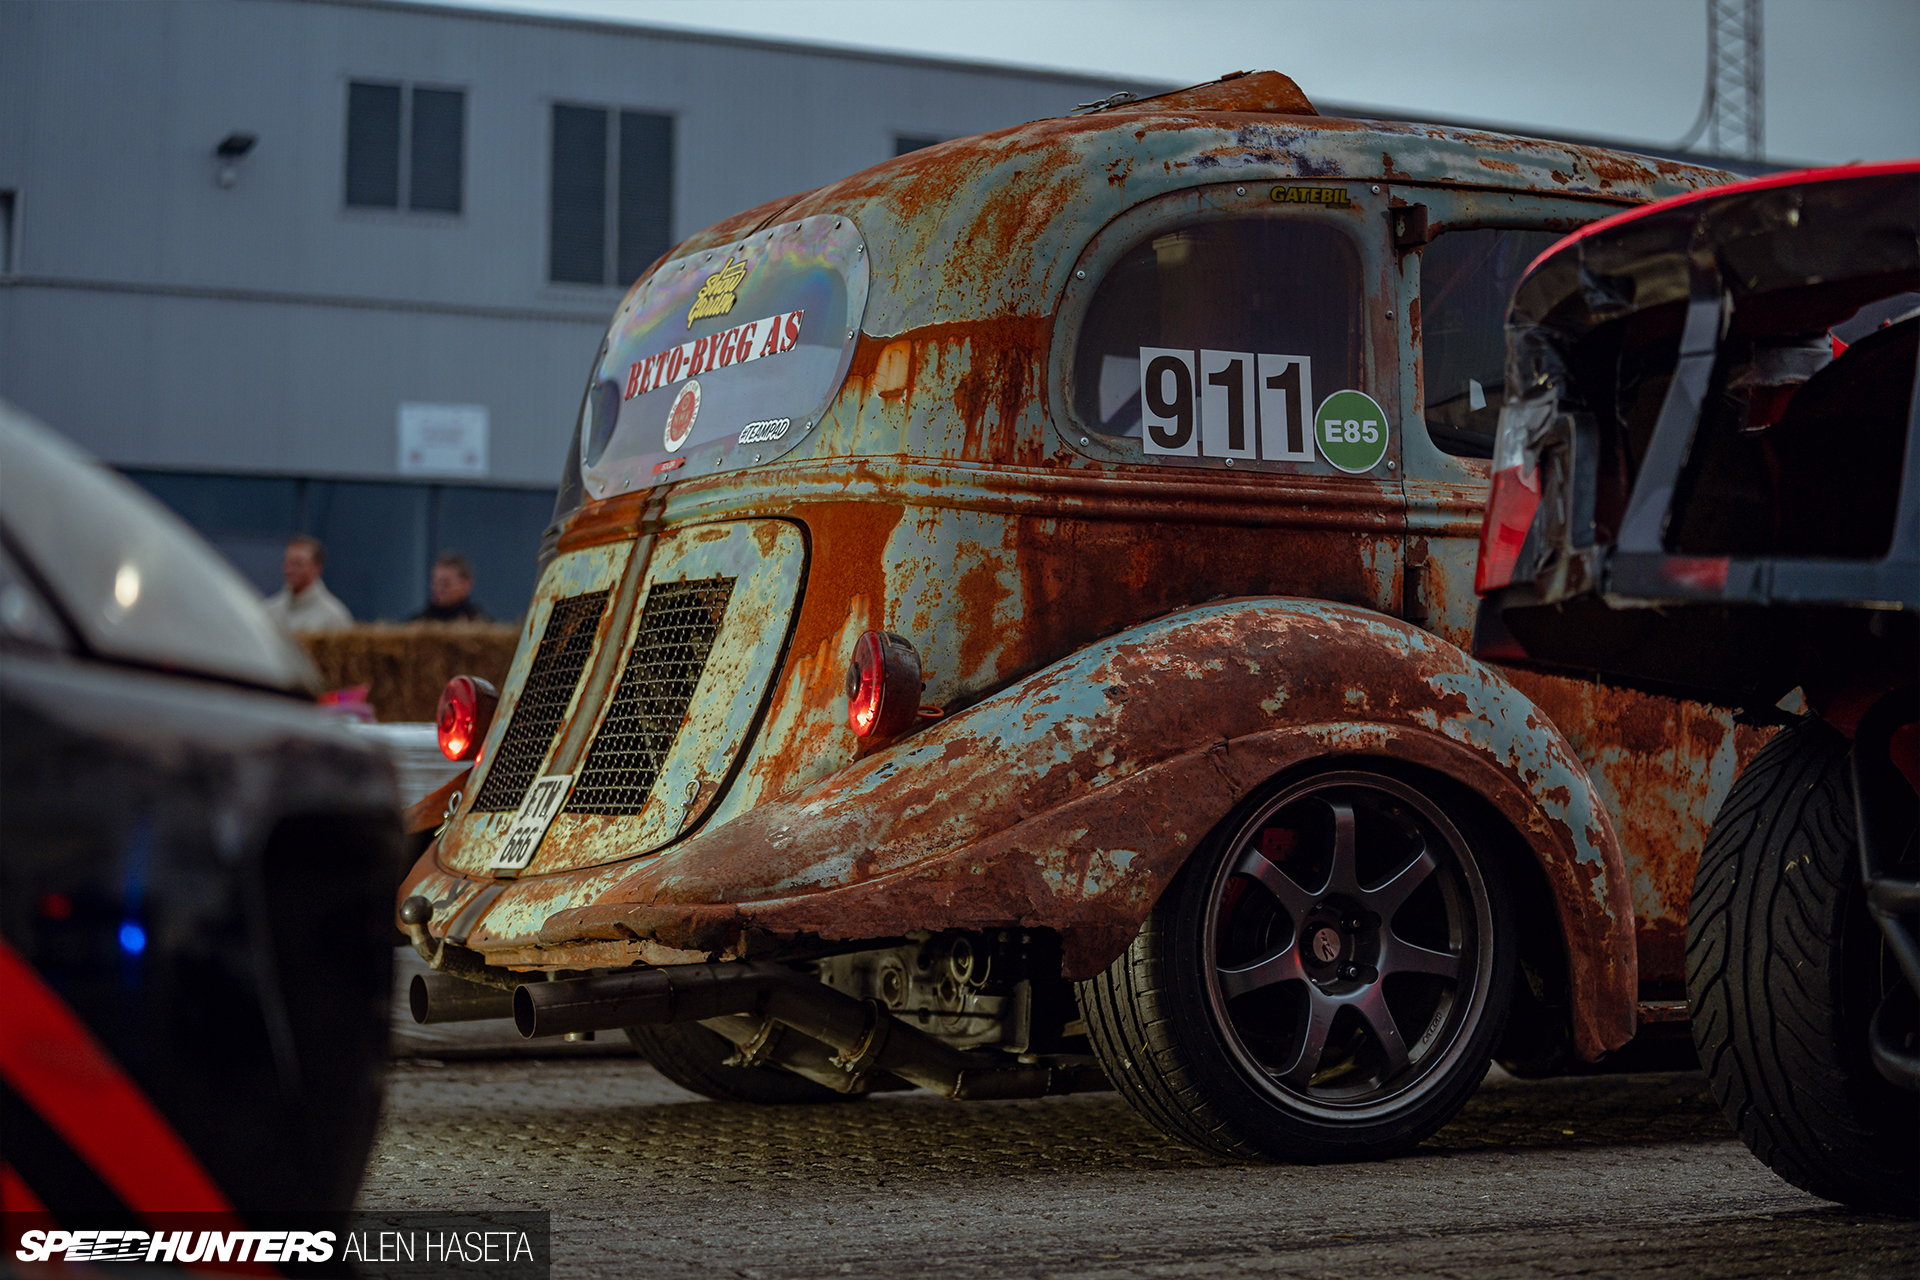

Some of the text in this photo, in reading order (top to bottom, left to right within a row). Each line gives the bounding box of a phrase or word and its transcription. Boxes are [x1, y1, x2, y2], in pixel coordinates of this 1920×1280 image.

[1270, 186, 1351, 204] GATEBIL
[624, 310, 803, 401] BETO-BYGG AS
[672, 409, 692, 427] NMK
[1145, 355, 1305, 453] 911
[1324, 419, 1379, 443] E85
[499, 826, 539, 863] 666
